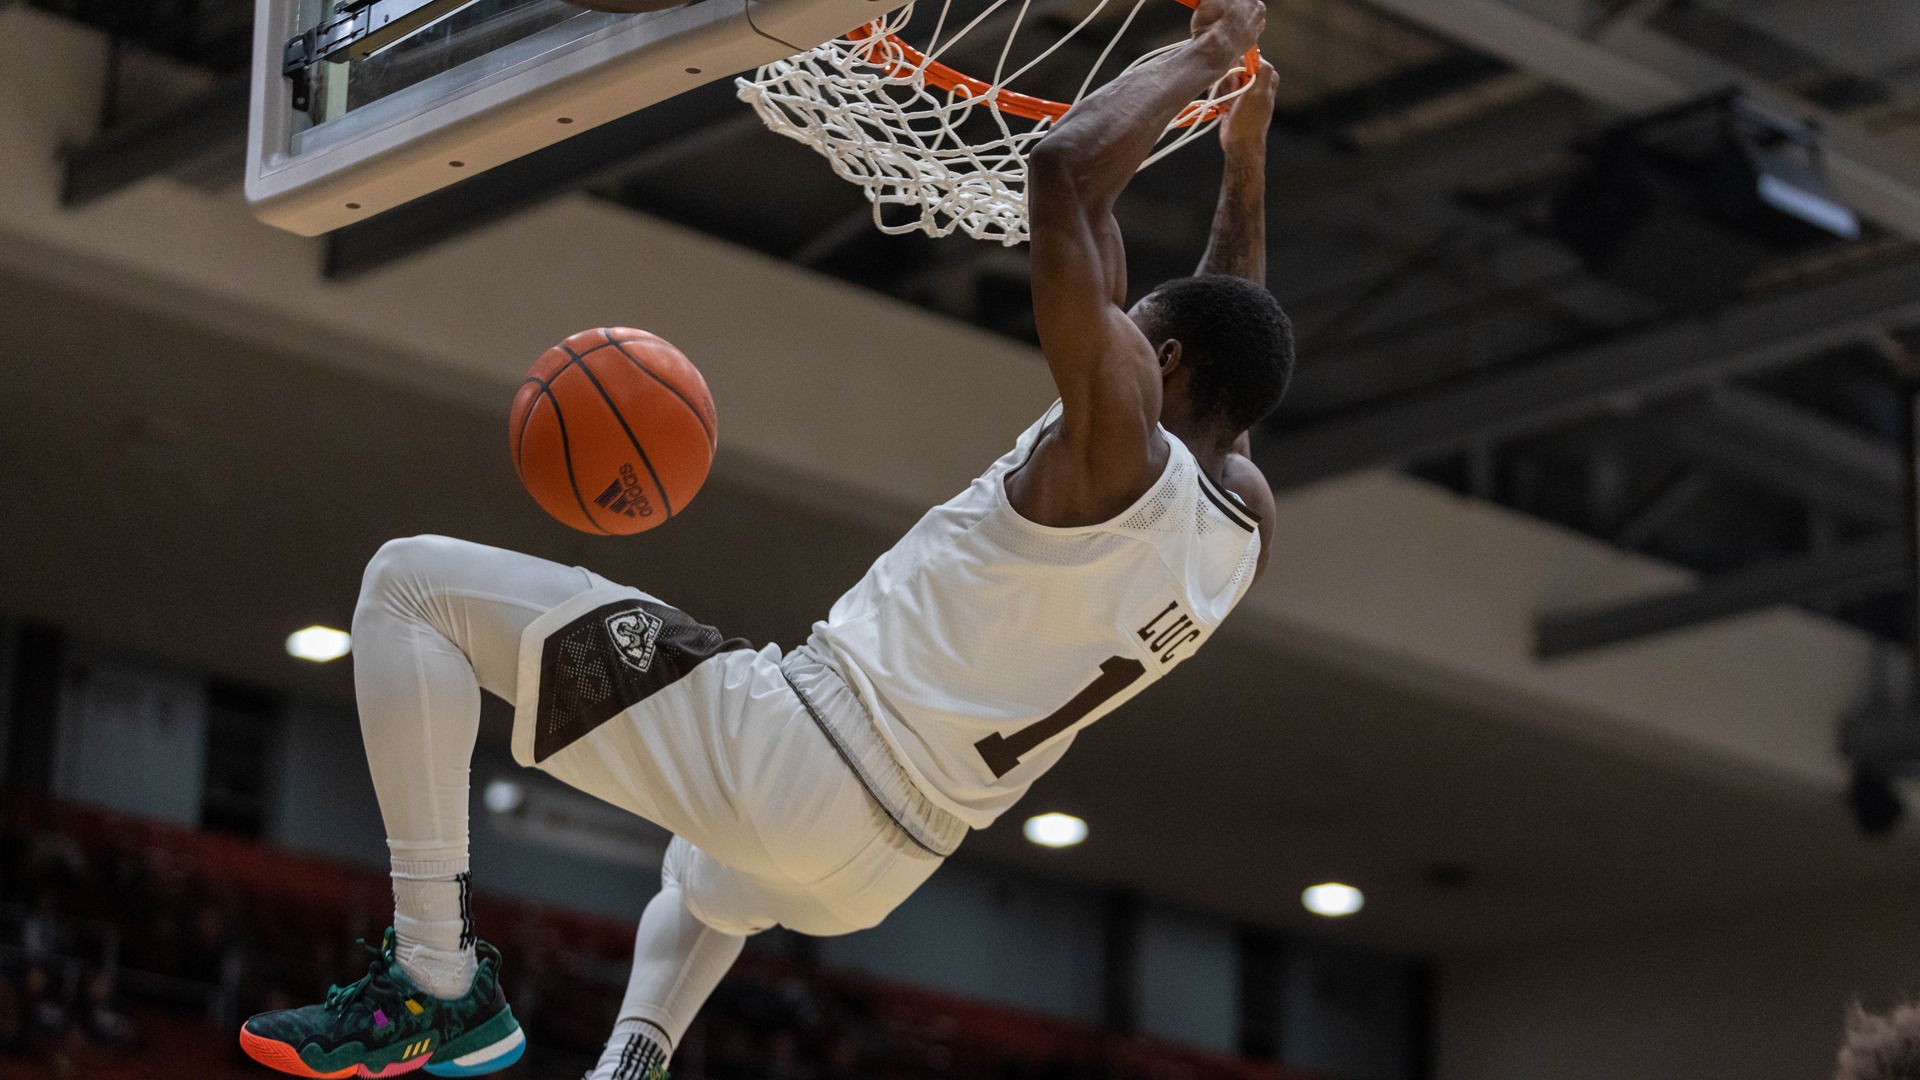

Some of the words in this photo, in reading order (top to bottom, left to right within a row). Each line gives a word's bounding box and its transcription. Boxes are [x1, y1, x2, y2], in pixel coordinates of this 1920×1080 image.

[619, 463, 652, 517] adidas
[639, 619, 659, 668] BONIES
[1137, 600, 1200, 664] LUC
[973, 655, 1147, 779] 1
